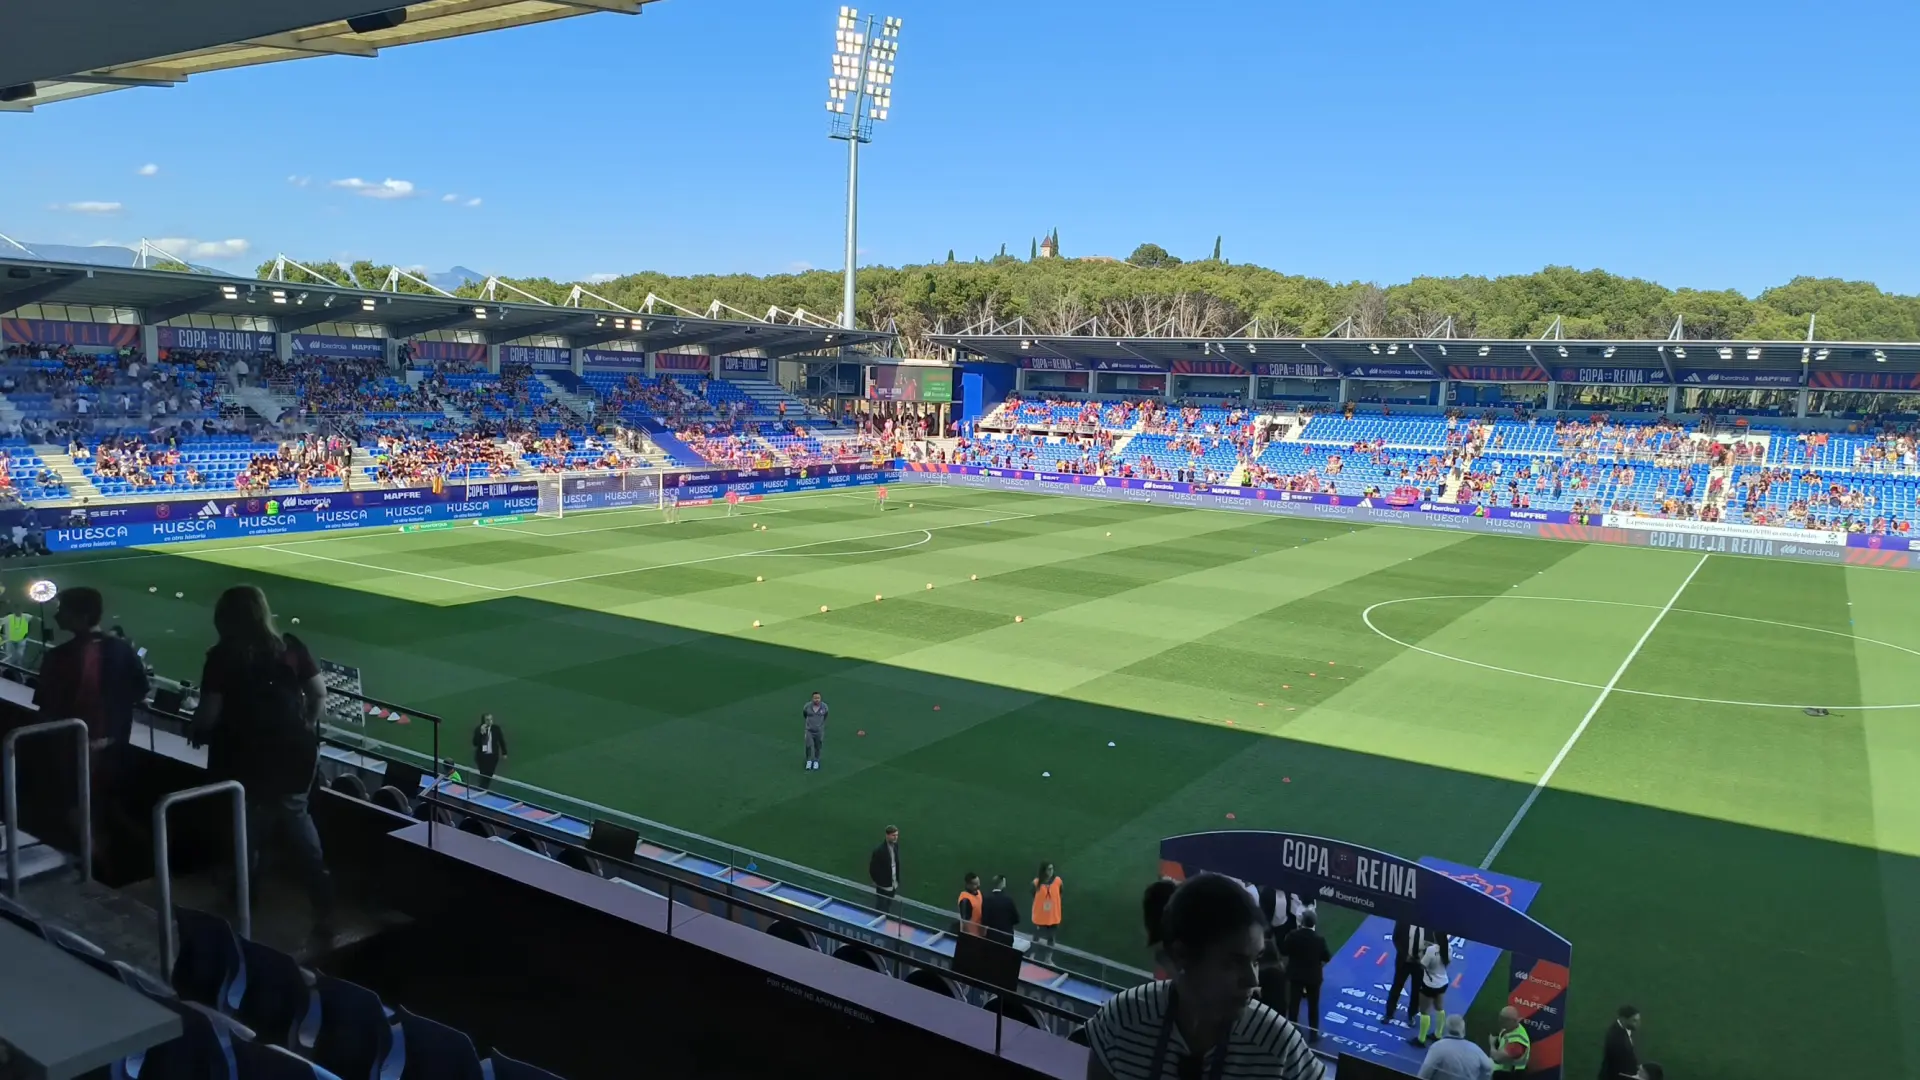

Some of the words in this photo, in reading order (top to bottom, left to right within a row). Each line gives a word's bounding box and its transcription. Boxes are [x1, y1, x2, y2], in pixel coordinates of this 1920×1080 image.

[178, 329, 208, 348] COPA
[219, 331, 252, 350] REINA
[321, 342, 347, 350] Iberdrola
[351, 343, 382, 351] MAPFRE
[509, 347, 529, 362] COPA
[534, 348, 556, 363] REINA
[725, 357, 739, 370] COPA
[742, 358, 758, 371] REINA
[1031, 358, 1048, 369] COPA
[1052, 358, 1072, 370] REINA
[1269, 363, 1289, 376] COPA
[1295, 364, 1319, 377] REINA
[1579, 368, 1604, 382] COPA
[1613, 369, 1643, 383] REINA
[1719, 374, 1750, 382] Iberdrola
[1755, 375, 1792, 383] MAPFRE
[689, 485, 718, 494] HUESCA
[727, 482, 755, 491] HUESCA
[763, 480, 788, 488] HUESCA
[384, 491, 421, 500] MAPFRE
[604, 491, 638, 500] HUESCA
[446, 501, 489, 512] HUESCA
[504, 498, 543, 508] HUESCA
[1314, 504, 1354, 514] HUESCA
[90, 509, 127, 518] SEAT
[316, 510, 368, 522] HUESCA
[385, 505, 432, 517] HUESCA
[1368, 508, 1410, 519] HUESCA
[1510, 511, 1548, 520] MAPFRE
[239, 514, 296, 528] HUESCA
[1425, 513, 1469, 524] HUESCA
[1485, 518, 1531, 530] HUESCA
[153, 520, 217, 534] HUESCA
[58, 526, 128, 541] HUESCA
[1650, 531, 1684, 548] COPA
[1689, 534, 1705, 550] DE
[1709, 535, 1726, 551] LA
[1731, 537, 1773, 555] REINA
[1797, 547, 1840, 558] Iberdrola
[1282, 838, 1329, 877] COPA
[1356, 856, 1417, 899] REINA
[1335, 890, 1375, 908] Iberdrola
[1529, 975, 1562, 990] Iberdrola
[1514, 996, 1558, 1015] MAPFRE
[843, 1005, 875, 1024] BEBIDAS
[1352, 1021, 1407, 1041] SEAT
[1321, 1031, 1389, 1056] renfe
